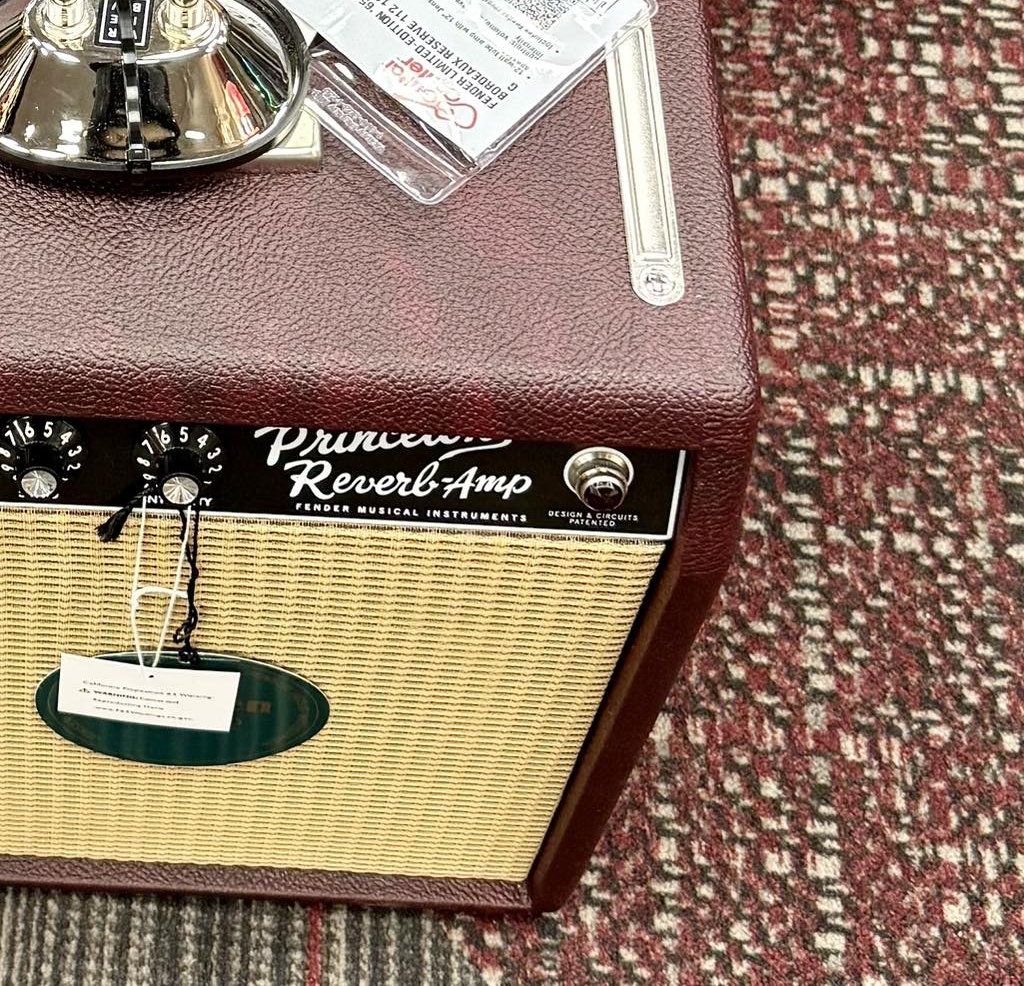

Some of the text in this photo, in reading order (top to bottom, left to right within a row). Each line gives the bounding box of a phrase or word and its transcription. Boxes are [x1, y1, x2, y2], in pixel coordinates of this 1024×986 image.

[386, 4, 409, 21] 112
[374, 10, 458, 78] LIMITED-EDITION
[405, 20, 454, 59] RESERVE
[450, 56, 508, 100] BORDEAUX
[455, 76, 498, 109] FENDER
[284, 459, 532, 500] Reverb-Amp
[295, 502, 528, 523] FENDER MUSICAL INSTRUMENTS
[548, 510, 583, 519] DESIGN
[595, 512, 639, 522] CIRCUITS
[568, 518, 616, 527] PATENTED
